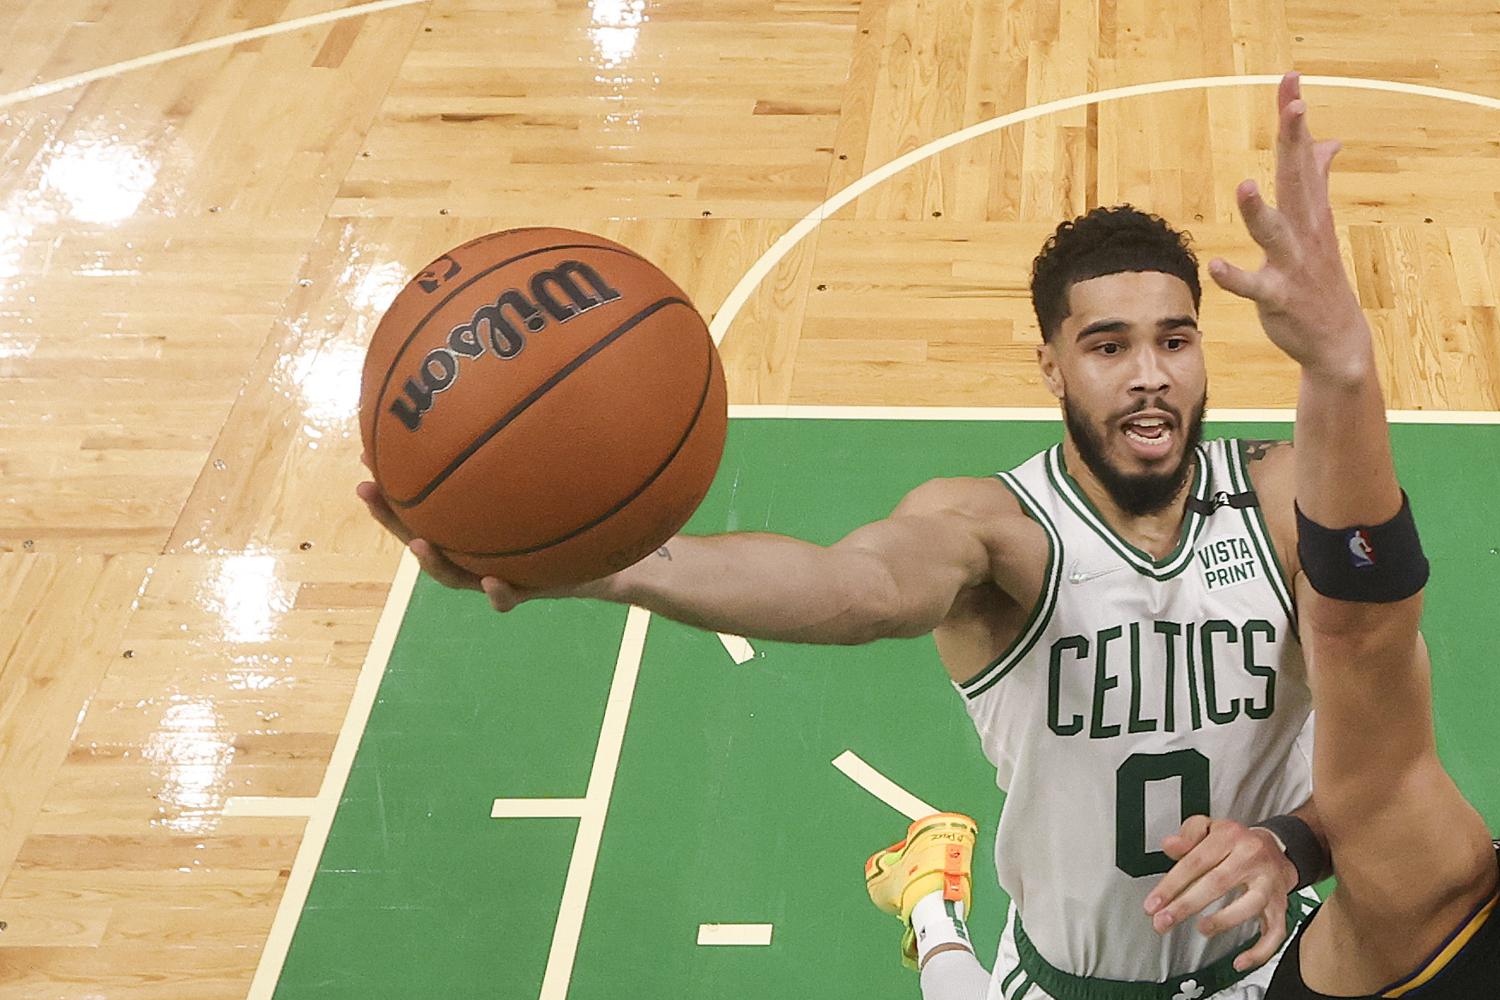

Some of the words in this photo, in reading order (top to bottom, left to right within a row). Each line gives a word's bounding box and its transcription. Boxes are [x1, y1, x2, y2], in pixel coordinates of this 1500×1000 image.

[389, 260, 623, 432] Wilson
[1198, 538, 1253, 569] VISTA
[1205, 561, 1255, 589] PRINT
[1047, 619, 1277, 739] CELTICS
[1116, 748, 1210, 877] 0
